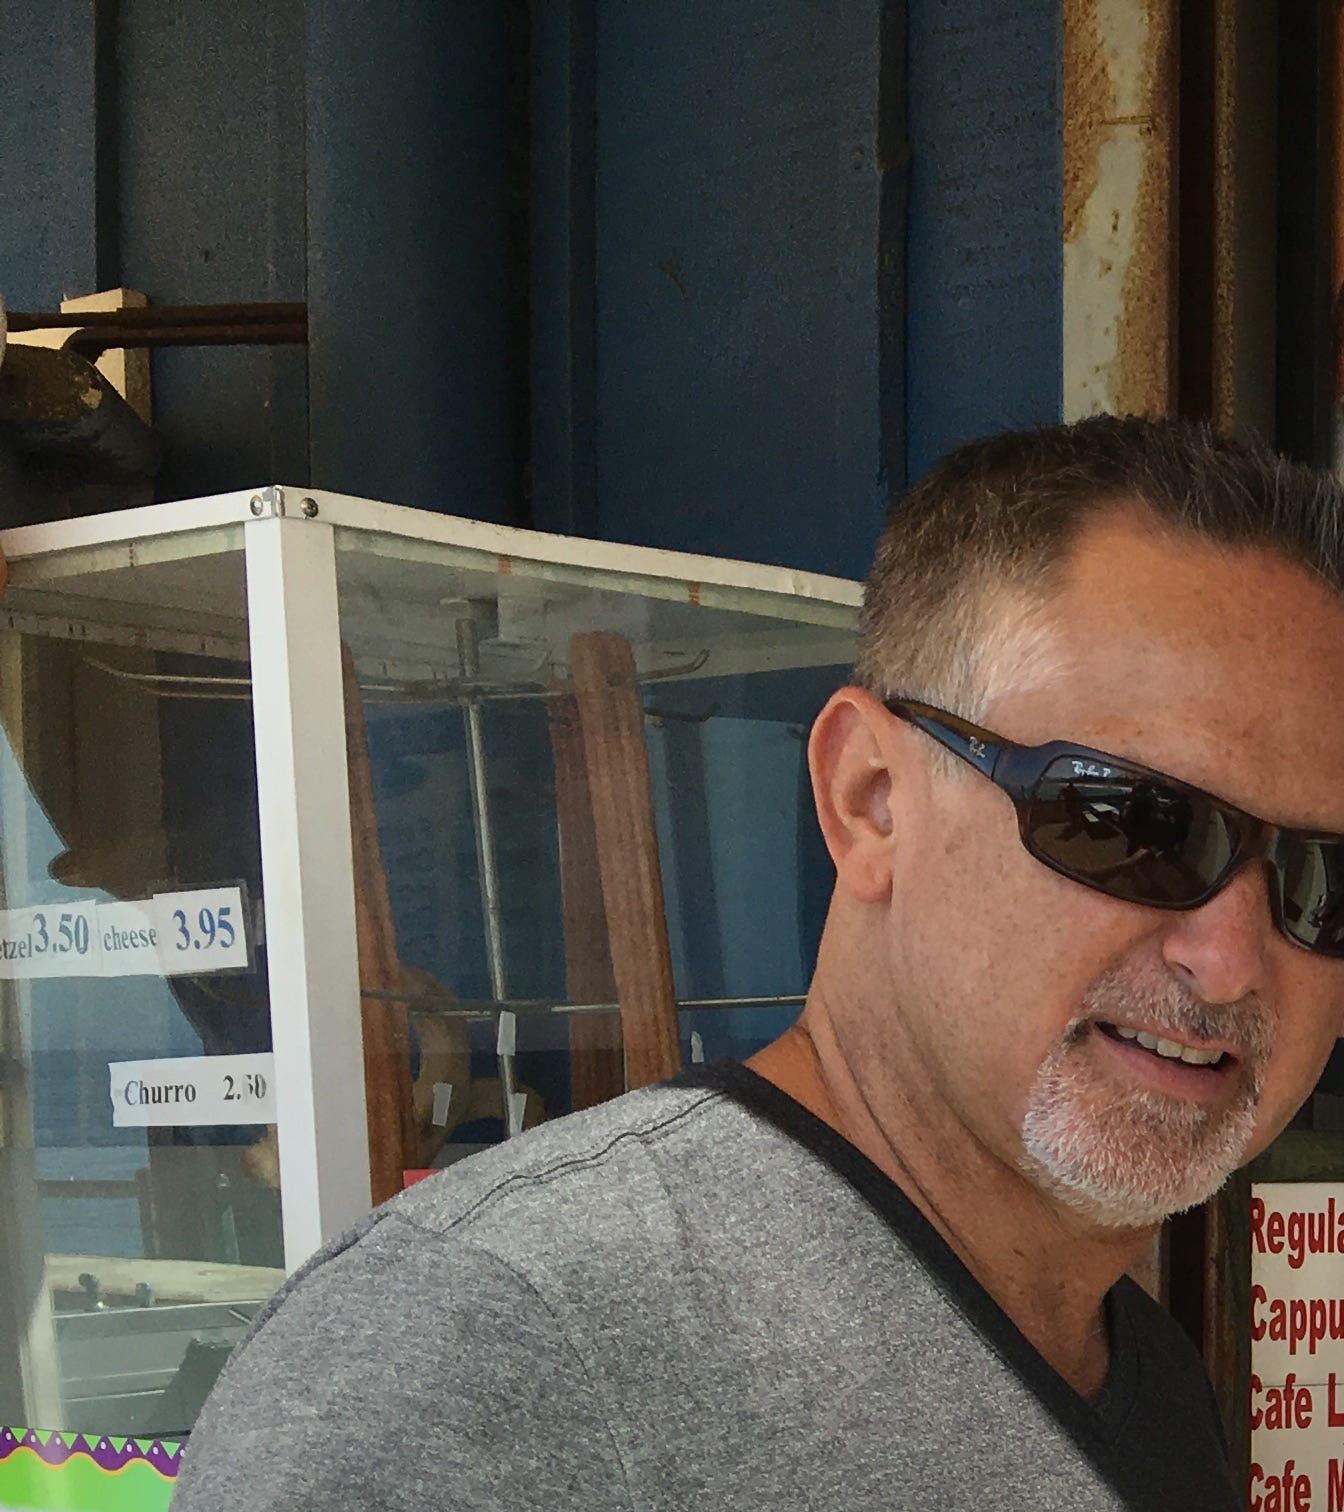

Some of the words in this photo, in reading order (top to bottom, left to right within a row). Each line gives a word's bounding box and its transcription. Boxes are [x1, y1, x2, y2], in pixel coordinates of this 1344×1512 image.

[33, 913, 89, 955] 3.50
[103, 926, 157, 951] cheese
[172, 907, 237, 951] 3.95
[125, 1078, 197, 1107] Churro
[1250, 1372, 1313, 1431] Cafe
